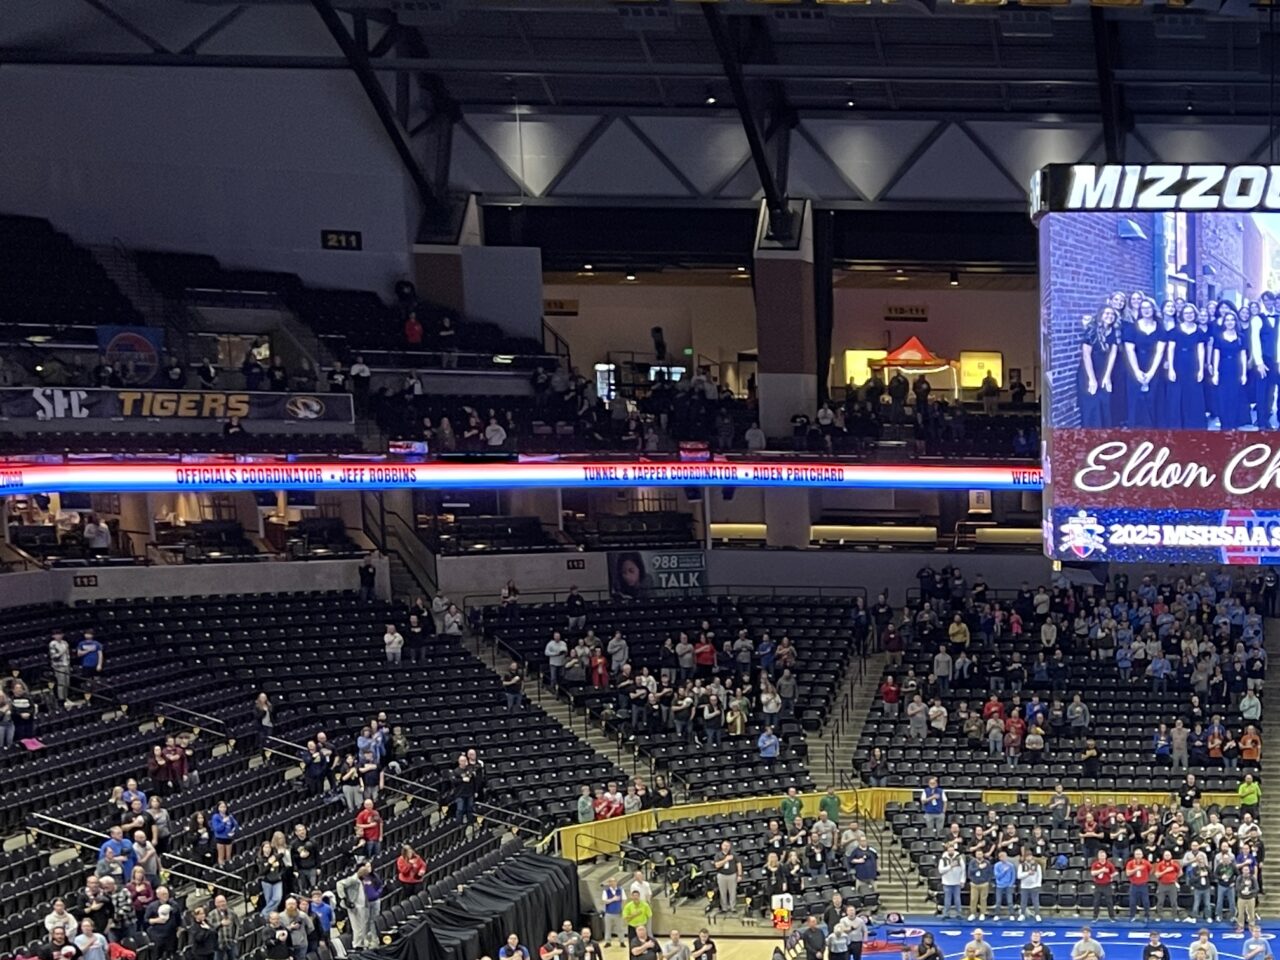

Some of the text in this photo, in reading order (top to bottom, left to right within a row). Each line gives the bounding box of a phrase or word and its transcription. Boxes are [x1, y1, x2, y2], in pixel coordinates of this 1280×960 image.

[327, 234, 357, 248] 211
[119, 391, 251, 417] TIGERS
[176, 467, 417, 485] OFFICIALS COORDINATOR JEFF ROBBINS
[582, 465, 620, 482] TUNNEL
[631, 465, 668, 482] TAPPER
[670, 465, 738, 482] COORDINATOR
[752, 466, 783, 483] AIDEN
[786, 466, 845, 483] PRITCHARD
[1074, 441, 1217, 493] Eldon
[1109, 524, 1162, 546] 2025
[1162, 524, 1270, 547] MSHSAA
[651, 555, 678, 569] 988
[658, 572, 700, 588] TALK
